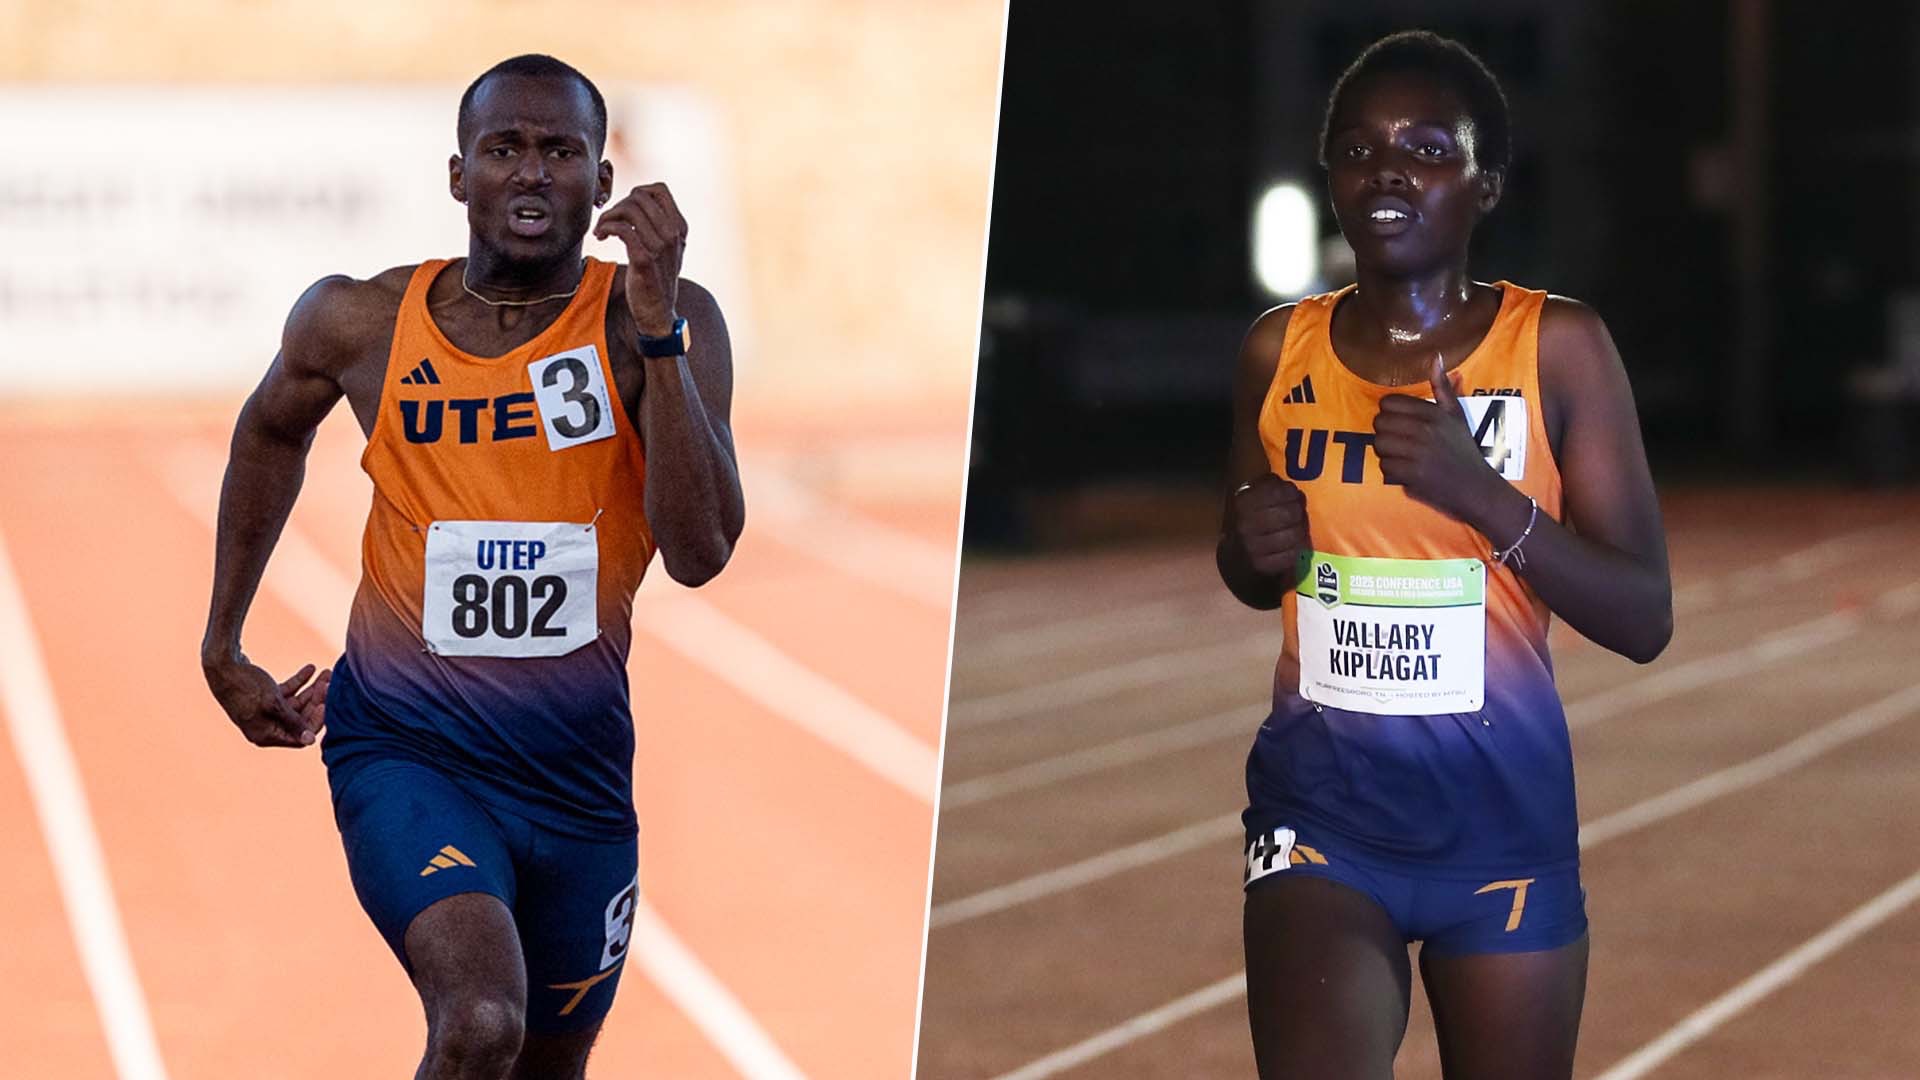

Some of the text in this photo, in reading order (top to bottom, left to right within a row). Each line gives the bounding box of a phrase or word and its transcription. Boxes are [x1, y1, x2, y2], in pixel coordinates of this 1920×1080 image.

[400, 392, 537, 443] UTE
[542, 357, 600, 438] 3
[1285, 428, 1404, 486] UT
[1474, 400, 1511, 473] 4
[477, 540, 546, 570] UTEP
[452, 574, 568, 638] 802
[1350, 576, 1374, 587] 2025
[1376, 577, 1441, 589] CONFERENCE
[1443, 576, 1463, 589] USA
[1333, 618, 1434, 650] VALLARY
[1329, 648, 1441, 681] KIPLAGAT
